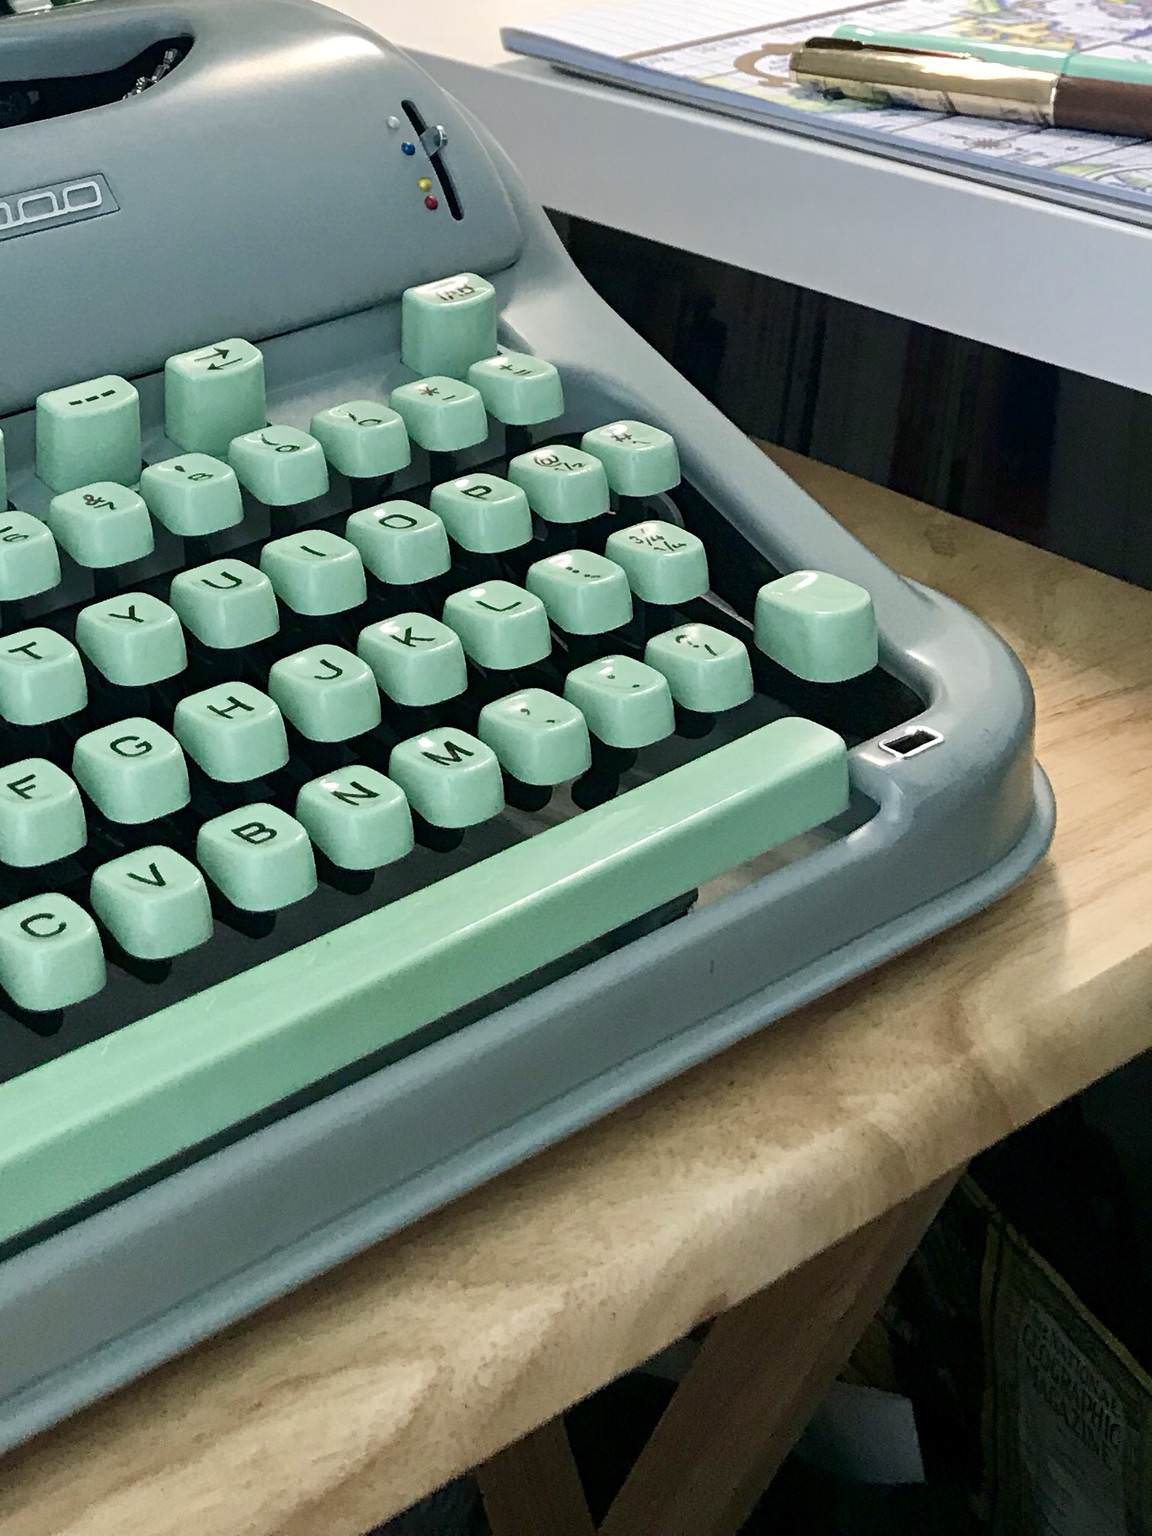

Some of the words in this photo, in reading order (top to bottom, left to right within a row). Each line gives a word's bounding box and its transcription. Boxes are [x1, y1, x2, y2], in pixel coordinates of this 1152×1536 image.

[8, 641, 42, 660] T
[108, 605, 144, 623] Y
[201, 571, 242, 589] U
[379, 514, 417, 529] O
[461, 486, 492, 500] P
[7, 774, 50, 800] F
[110, 736, 152, 757] G
[207, 696, 254, 719] H
[314, 659, 343, 680] J
[390, 627, 435, 647] K
[475, 597, 521, 612] L
[20, 913, 67, 938] C
[127, 863, 166, 887] V
[231, 822, 277, 845] B
[331, 781, 380, 806] N
[421, 740, 475, 767] M
